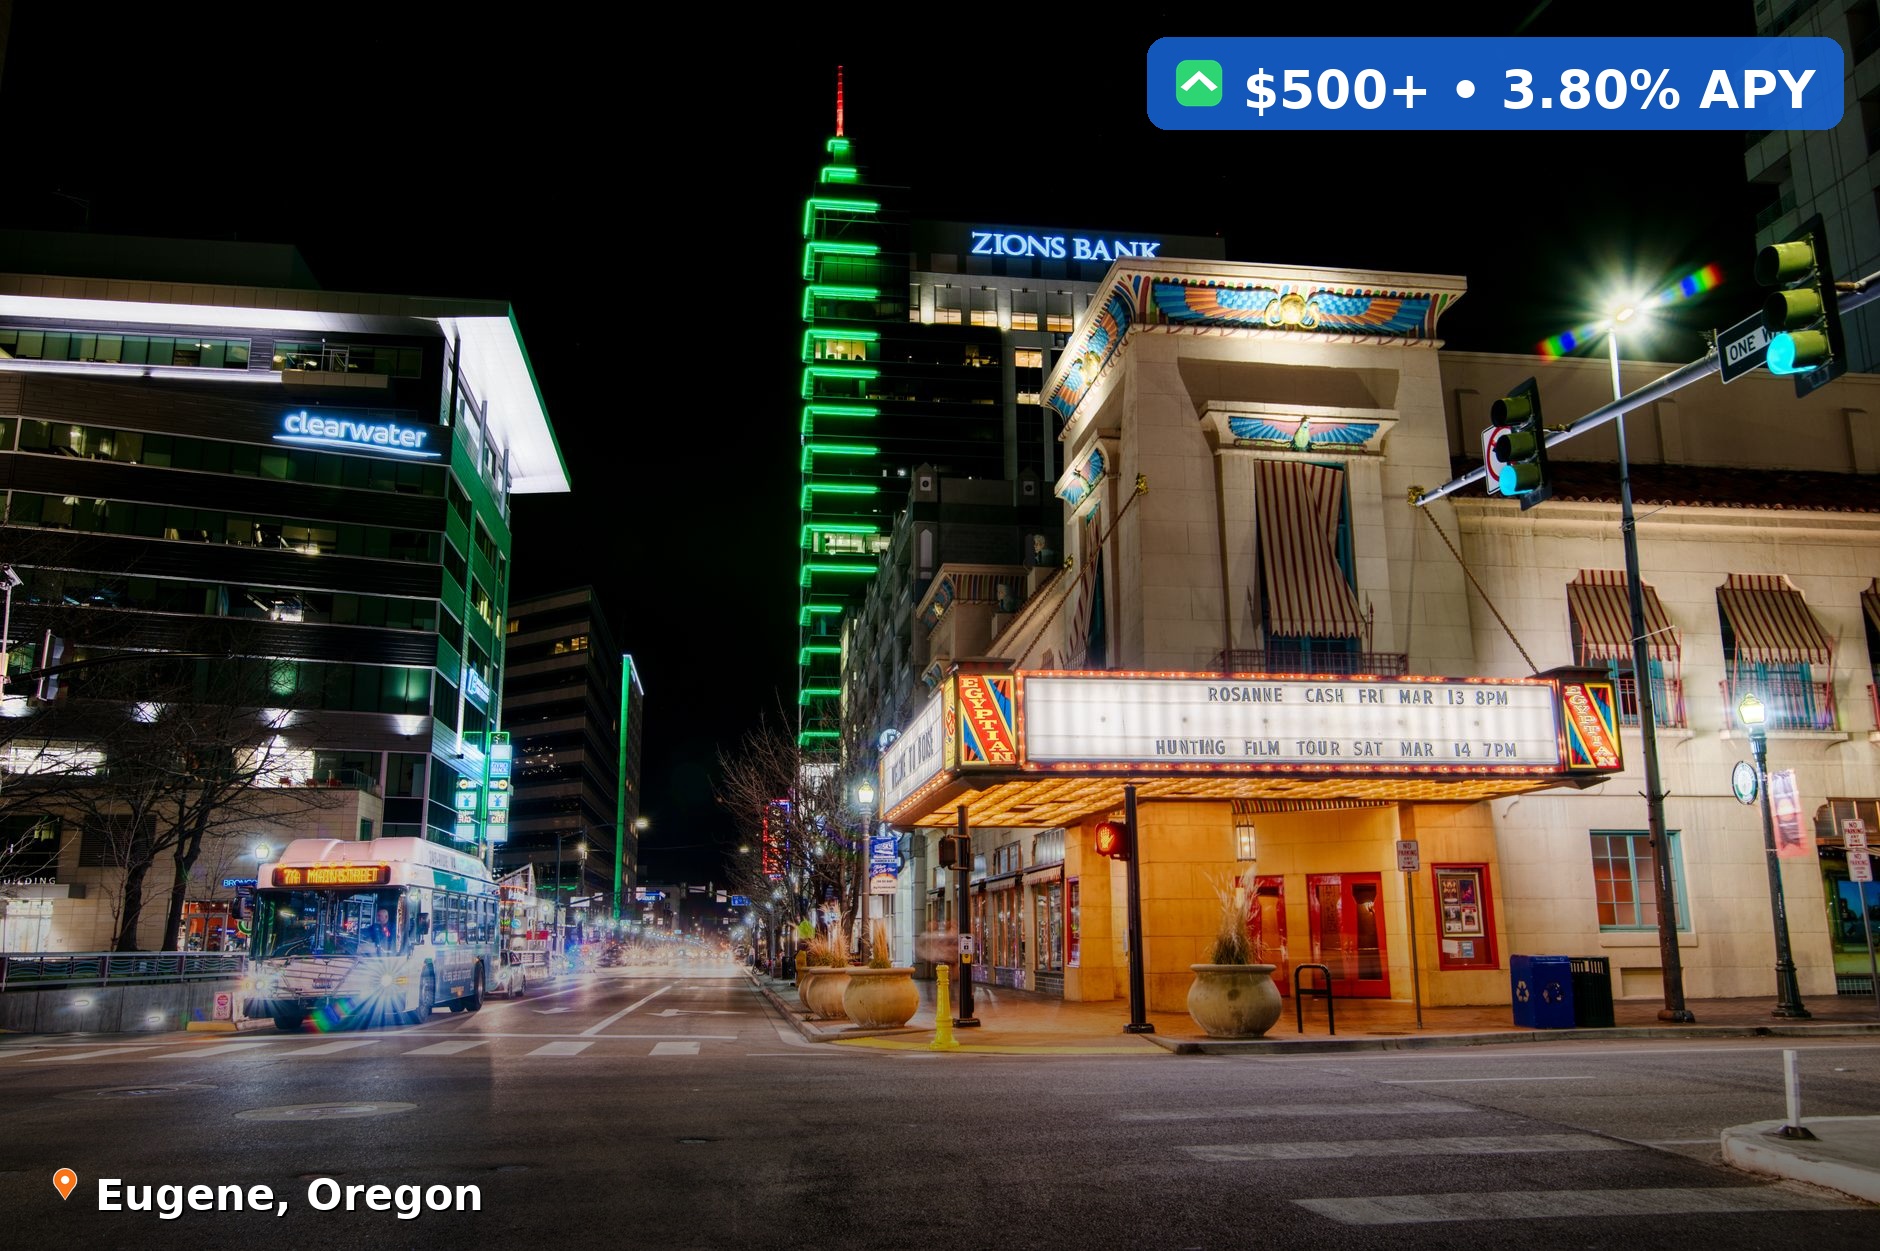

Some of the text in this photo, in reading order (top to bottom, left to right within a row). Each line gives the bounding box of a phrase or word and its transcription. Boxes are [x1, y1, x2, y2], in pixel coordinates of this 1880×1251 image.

[972, 231, 1161, 262] ZIONS BANK
[1729, 335, 1756, 361] ONE
[284, 411, 427, 448] clearwater
[1208, 686, 1508, 705] ROSANNE CASH FRI MAR 13 8PM
[961, 677, 1014, 763] EGYPTIAN
[1564, 685, 1618, 767] EGYPTIAN
[1155, 739, 1518, 758] HUNTING FILM TOUR SAT MAR 14 7PM
